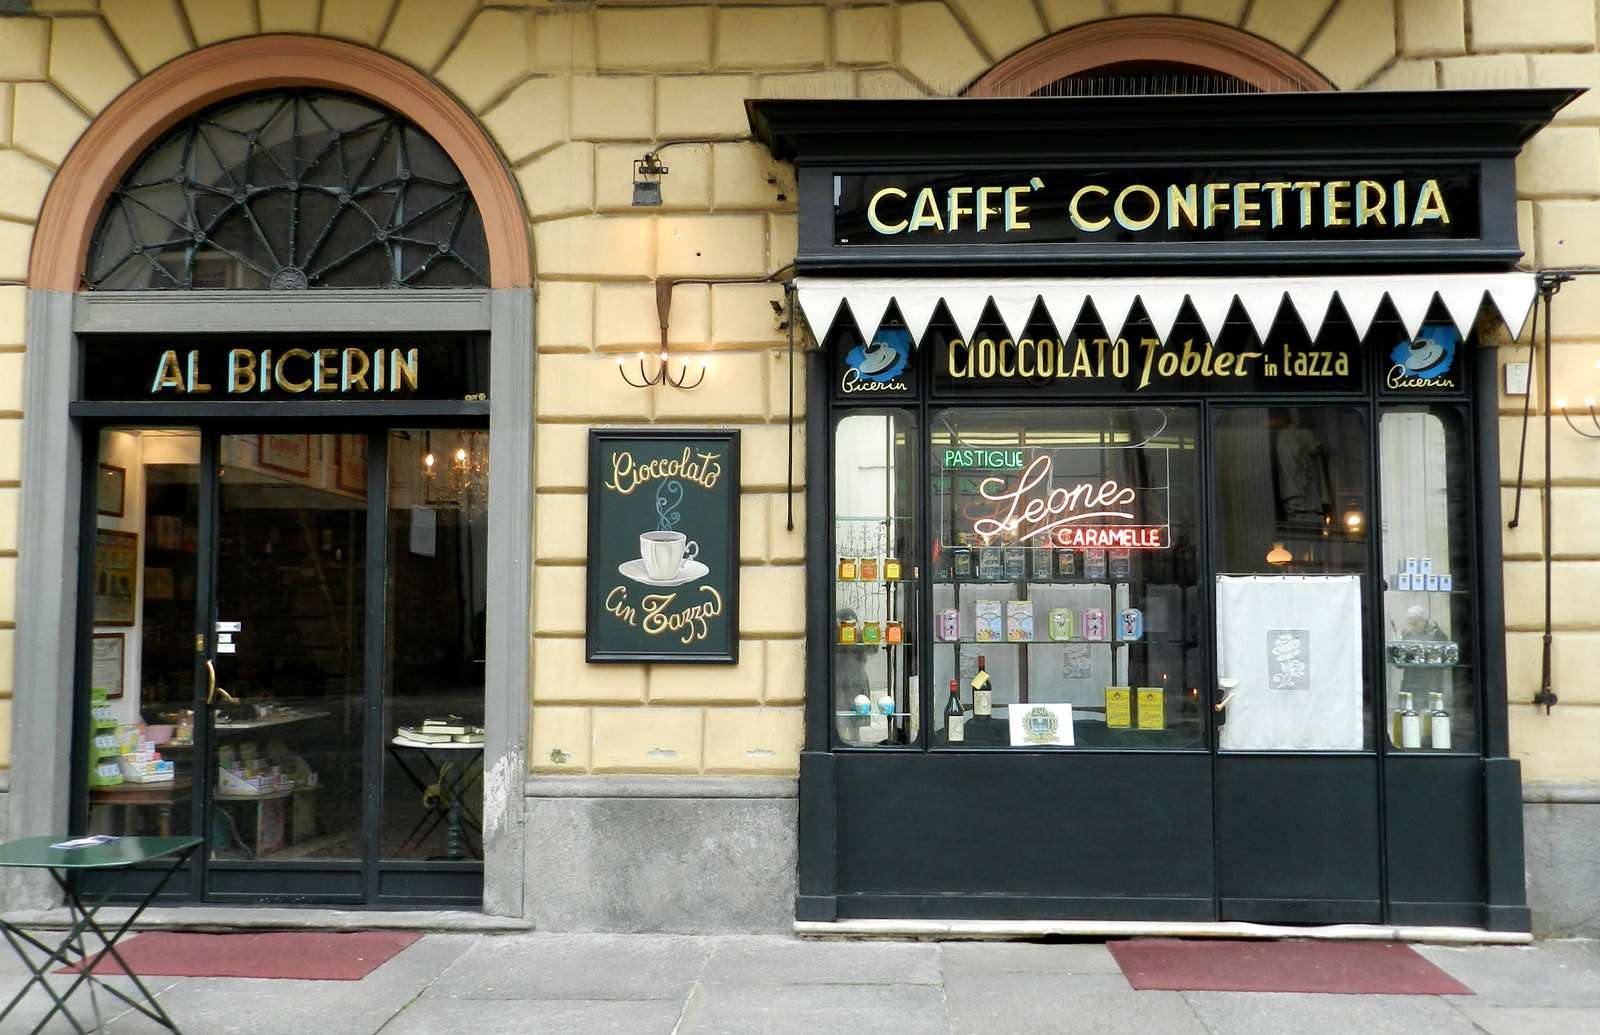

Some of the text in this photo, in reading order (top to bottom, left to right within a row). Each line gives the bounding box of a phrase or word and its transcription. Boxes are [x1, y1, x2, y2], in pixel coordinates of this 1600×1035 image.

[1069, 178, 1451, 233] CONFETTERIA
[151, 347, 419, 393] AL BICERIN
[841, 368, 908, 394] Bicerin
[949, 337, 1349, 391] CIOCCOLATO Tobler in tazza
[1386, 364, 1455, 389] Bicerin
[605, 446, 722, 494] Cioccolato
[1057, 528, 1162, 547] CARAMELLE
[641, 585, 723, 644] Tazza
